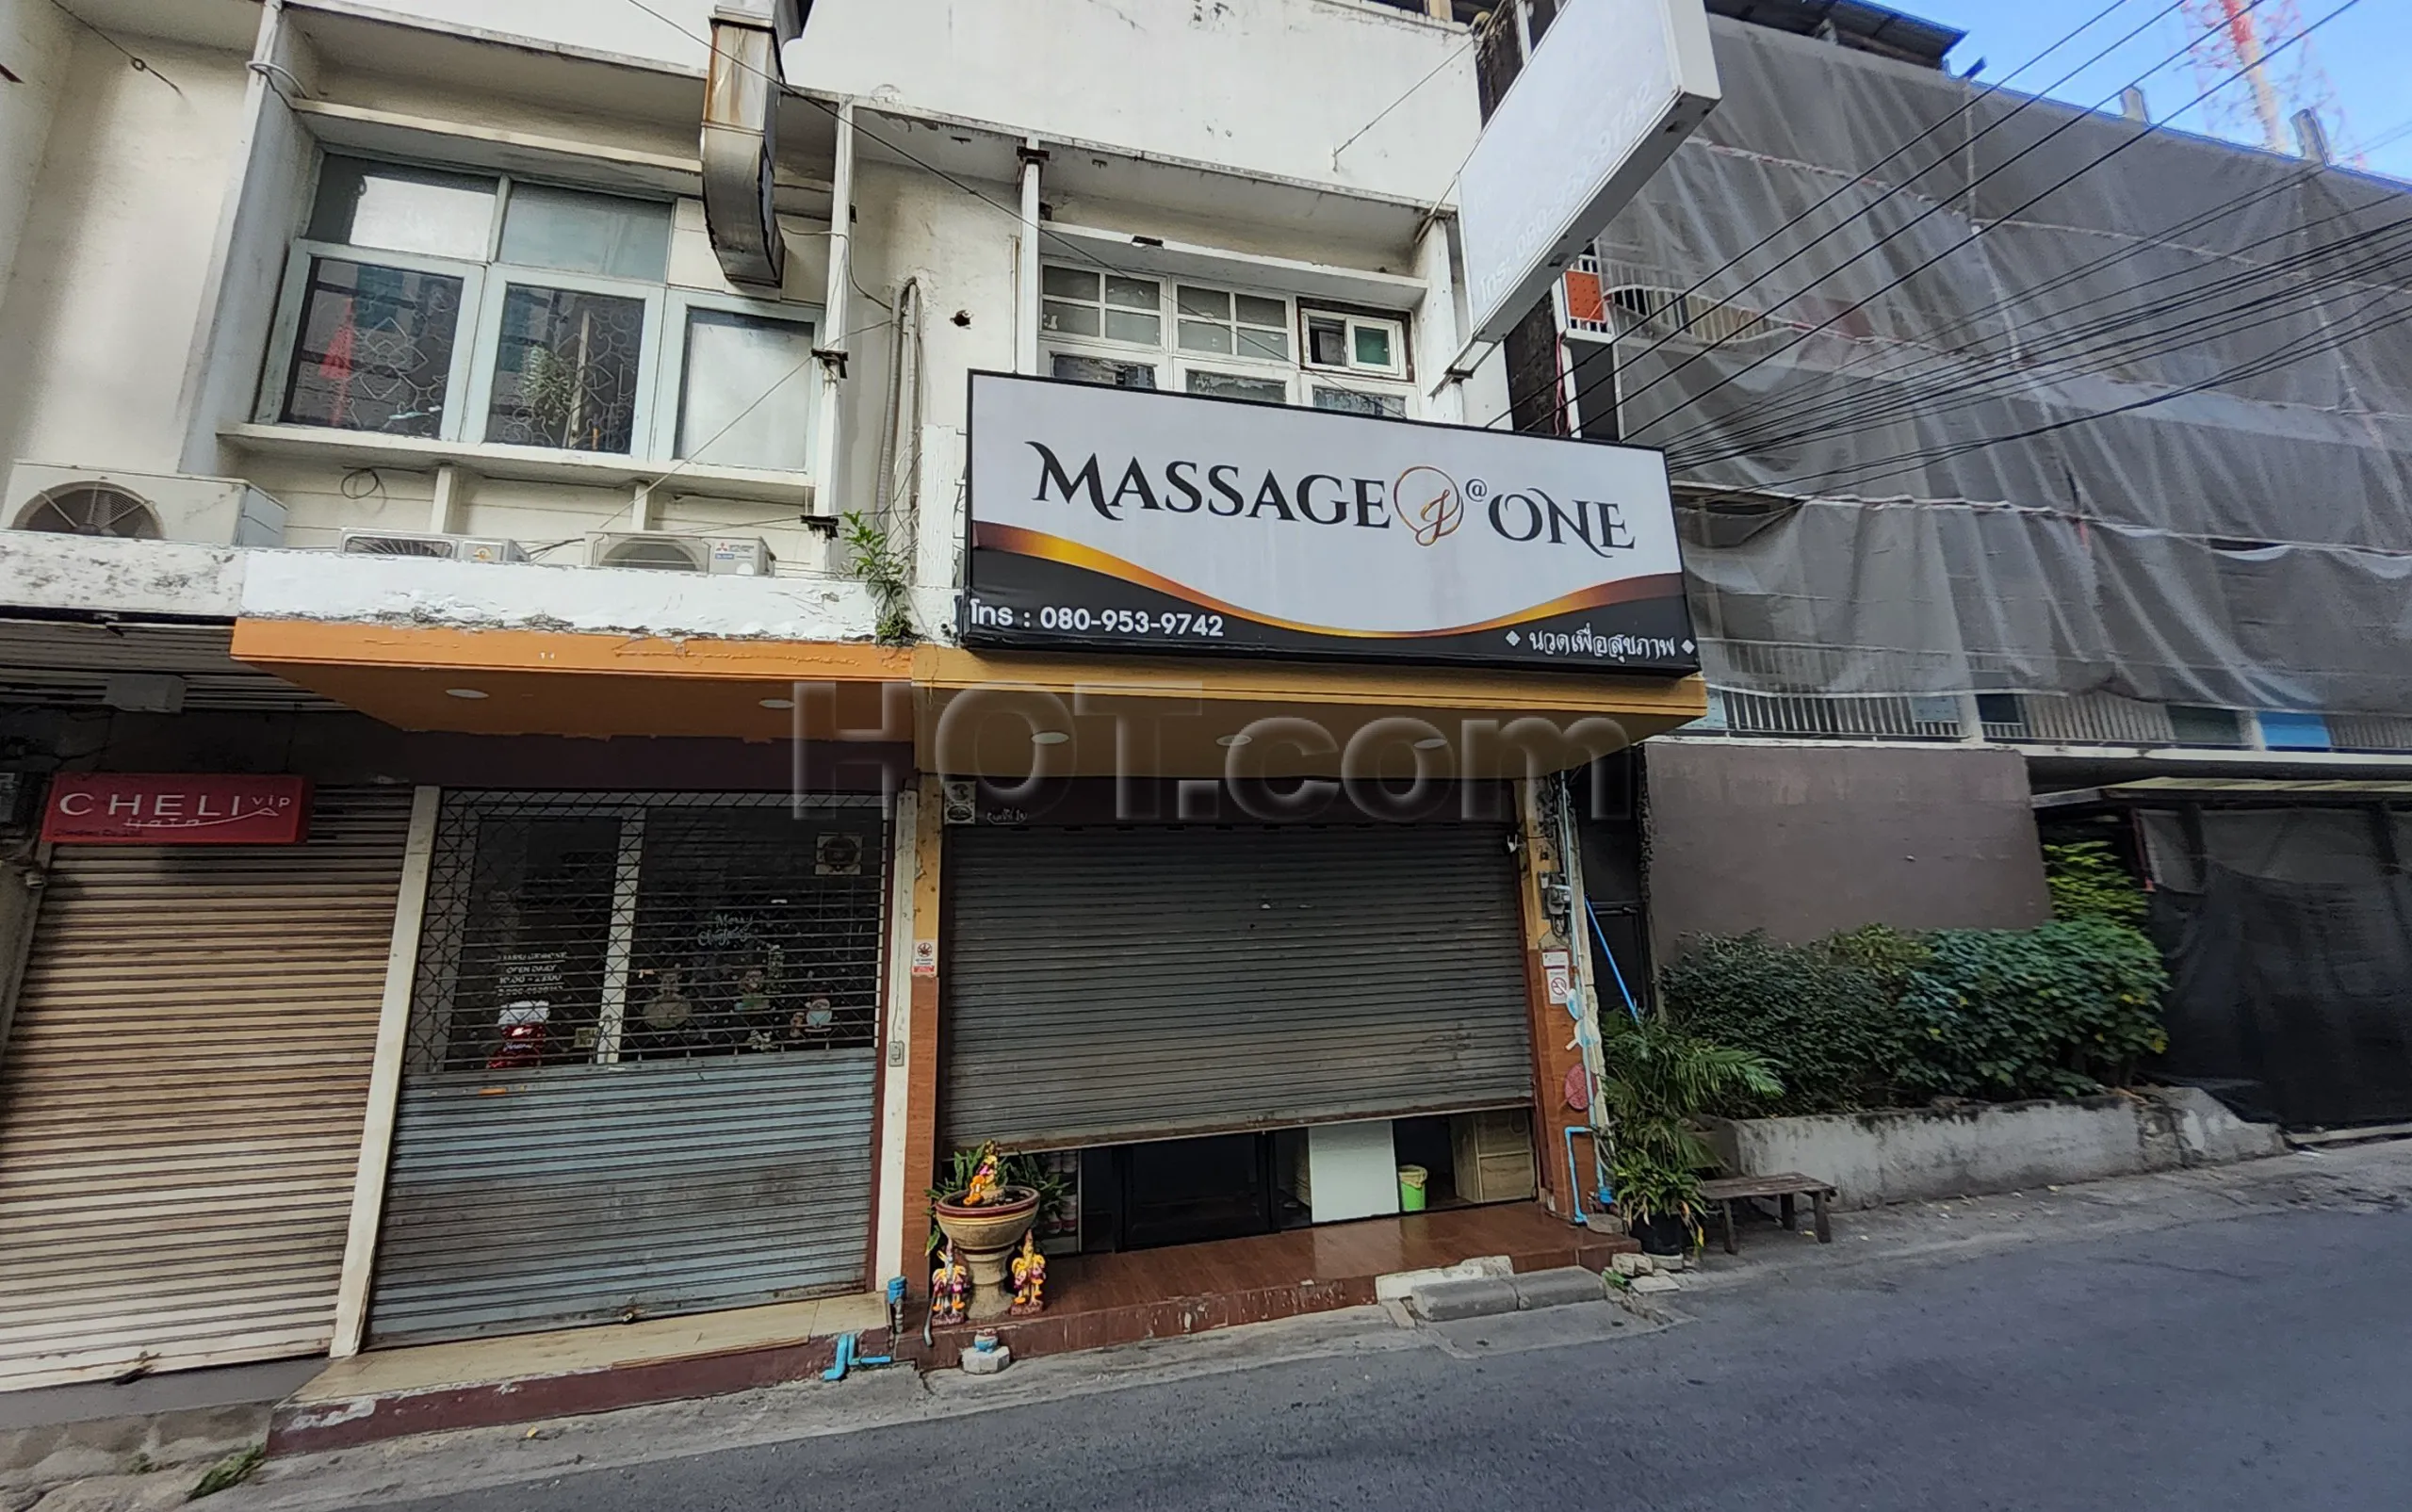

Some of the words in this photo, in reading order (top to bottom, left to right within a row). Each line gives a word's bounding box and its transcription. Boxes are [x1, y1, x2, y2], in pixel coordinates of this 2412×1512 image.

[1024, 441, 1392, 529] MASSAGE
[1488, 487, 1637, 559] ONE
[1039, 606, 1225, 638] 080-953-9742
[1528, 622, 1676, 664] นวดเพื่อสุขภาพ
[58, 792, 241, 817] CHELI
